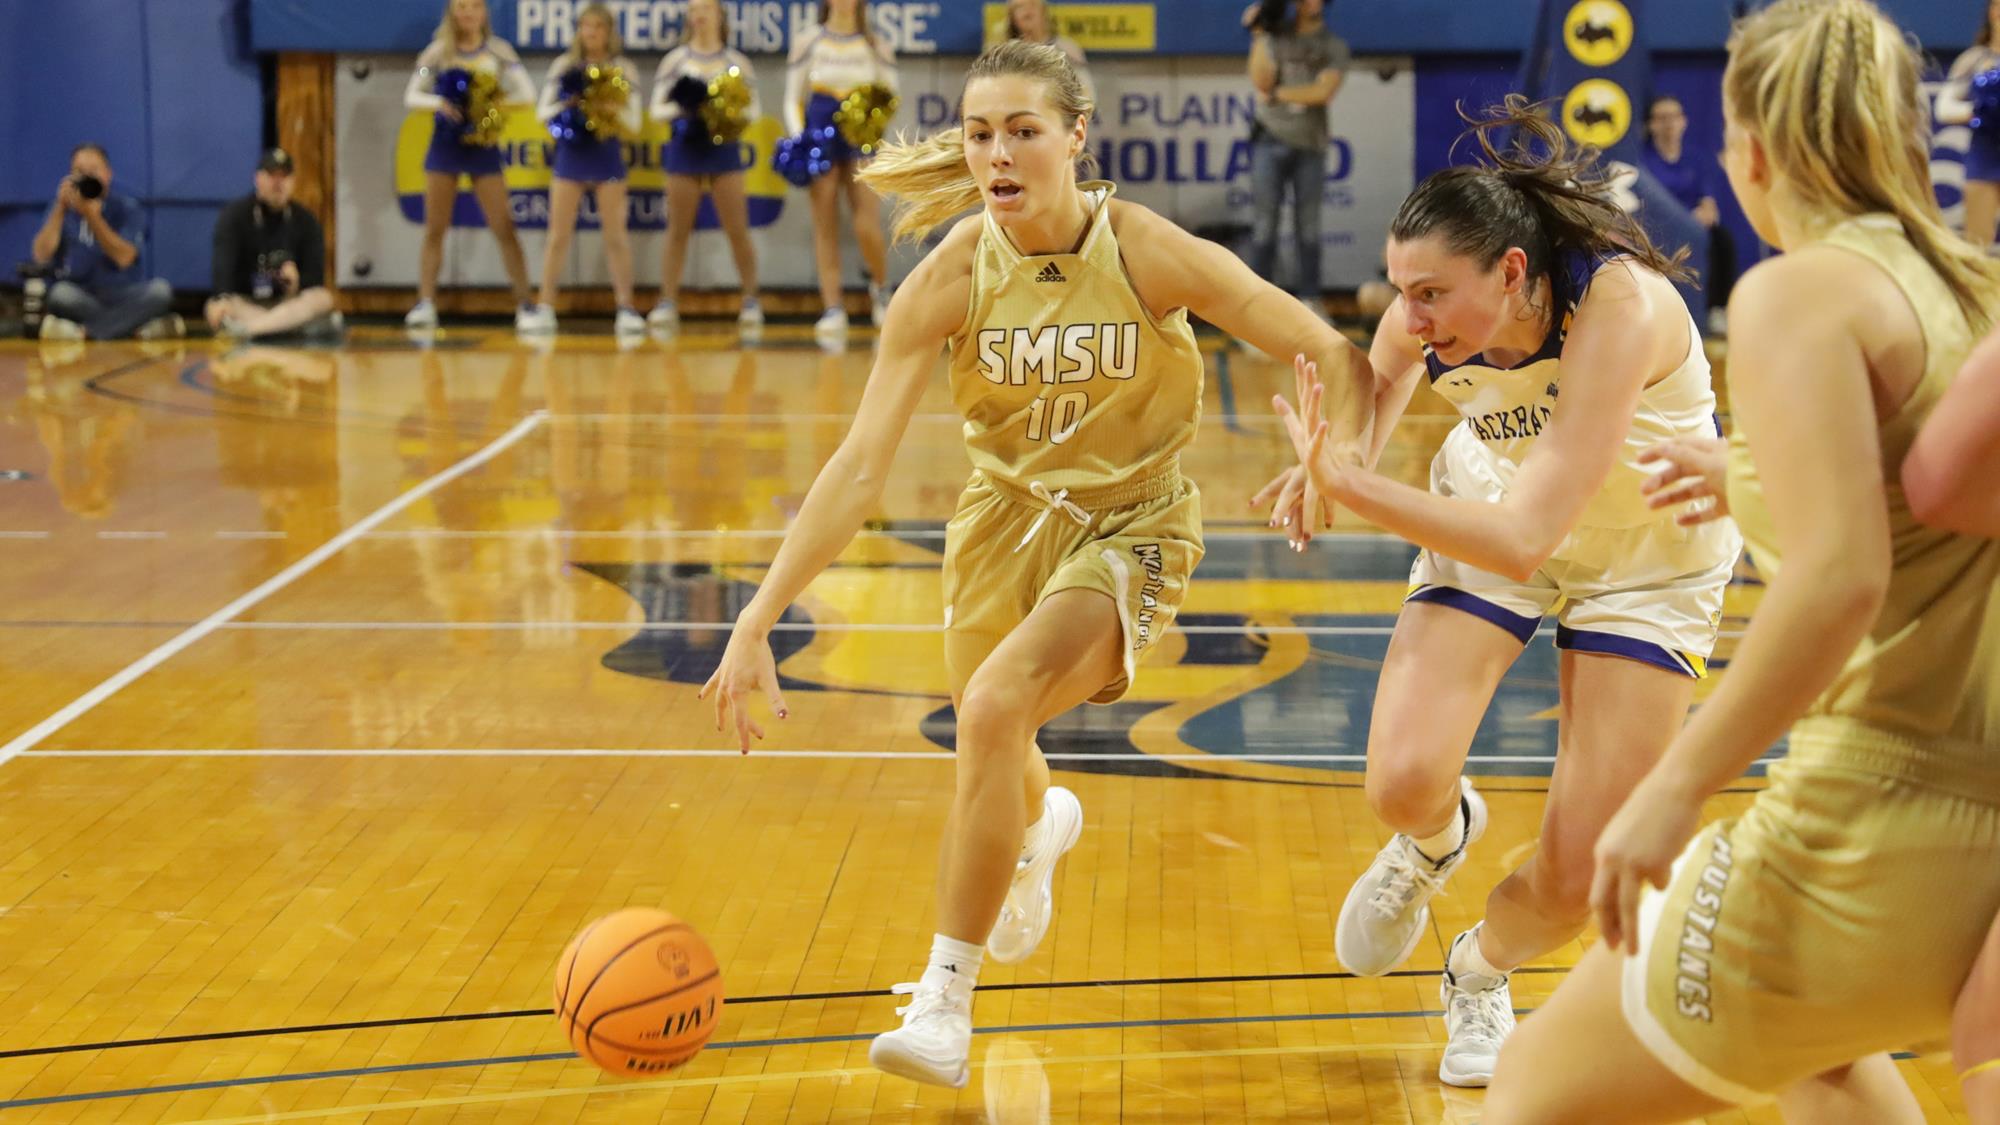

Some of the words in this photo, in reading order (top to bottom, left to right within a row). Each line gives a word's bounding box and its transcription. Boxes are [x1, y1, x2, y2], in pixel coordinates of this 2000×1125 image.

[726, 2, 783, 51] HIS
[1121, 93, 1256, 127] PLAIN
[1035, 274, 1067, 283] adidas
[976, 321, 1139, 386] SMSU
[1025, 390, 1089, 445] 10
[1676, 832, 1733, 1023] MUSTANGS
